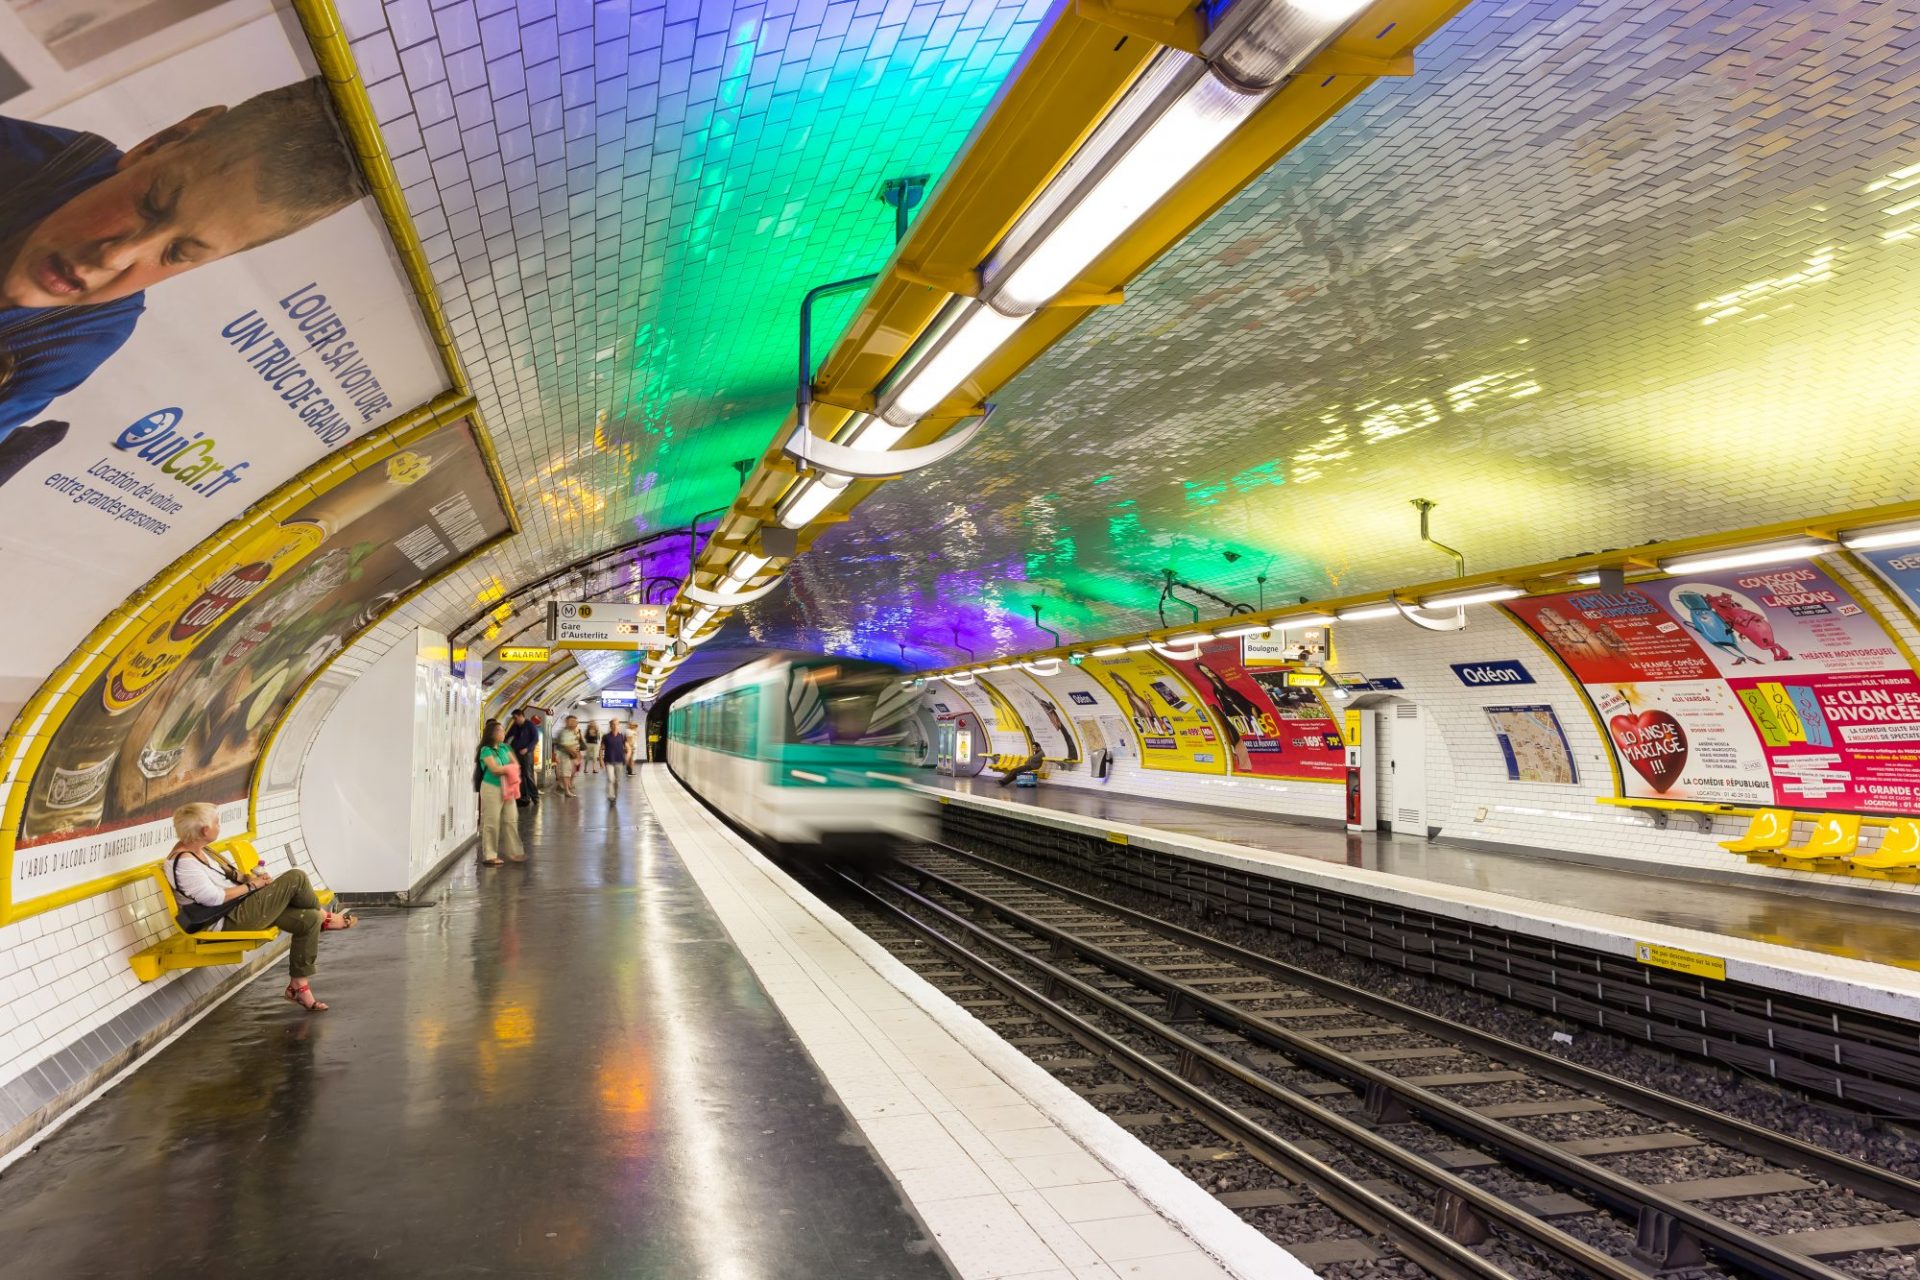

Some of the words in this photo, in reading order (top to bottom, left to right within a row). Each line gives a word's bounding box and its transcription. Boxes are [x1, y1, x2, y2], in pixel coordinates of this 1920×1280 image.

[279, 282, 347, 353] LOUER
[221, 309, 275, 353] UN
[247, 337, 307, 391] TRUC
[321, 341, 359, 372] SA
[280, 378, 322, 410] DE
[335, 358, 392, 424] VOITURE,
[87, 457, 136, 492] Location
[132, 483, 153, 500] de
[149, 494, 184, 516] voiture
[44, 473, 85, 497] entre
[73, 488, 124, 516] grandes
[115, 506, 171, 536] personnes
[1888, 555, 1920, 570] BE
[1739, 569, 1817, 589] COUSCOUS
[1772, 583, 1804, 595] AUX
[1568, 590, 1649, 609] FAMILLES
[1761, 591, 1838, 607] LARDONS
[179, 599, 229, 626] Club
[580, 607, 591, 616] 10
[561, 622, 581, 631] Gare
[561, 631, 608, 640] d'Austerlitz
[512, 651, 549, 659] ALARME
[1247, 644, 1279, 654] Boulogne
[1835, 647, 1897, 658] MONTORGUEIL
[141, 653, 168, 678] 3
[1641, 660, 1673, 669] GRANDE
[1673, 657, 1708, 667] COMÉDIE
[1463, 666, 1522, 683] Odéon
[1821, 695, 1838, 705] LE
[1837, 689, 1892, 705] CLAN
[1893, 692, 1920, 703] DES
[1824, 703, 1920, 720] DIVORCÉE
[1620, 731, 1637, 745] 10
[1638, 724, 1664, 742] ANS
[1661, 722, 1678, 735] DE
[1860, 726, 1887, 734] COMÉDIE
[1623, 737, 1685, 761] MARIAGE
[1693, 777, 1724, 787] COMÉDIE
[1726, 778, 1770, 788] RÉPUBLIQUE
[1854, 784, 1867, 794] LA
[1868, 785, 1911, 796] GRANDE
[1864, 799, 1898, 807] LOCATION
[20, 855, 48, 880] L'ABUS
[52, 847, 87, 872] D'ALCOOL
[90, 844, 102, 863] EST
[104, 836, 136, 860] DANGEREUX
[139, 832, 153, 848] POUR
[155, 827, 162, 843] LA
[1670, 952, 1694, 963] descendre
